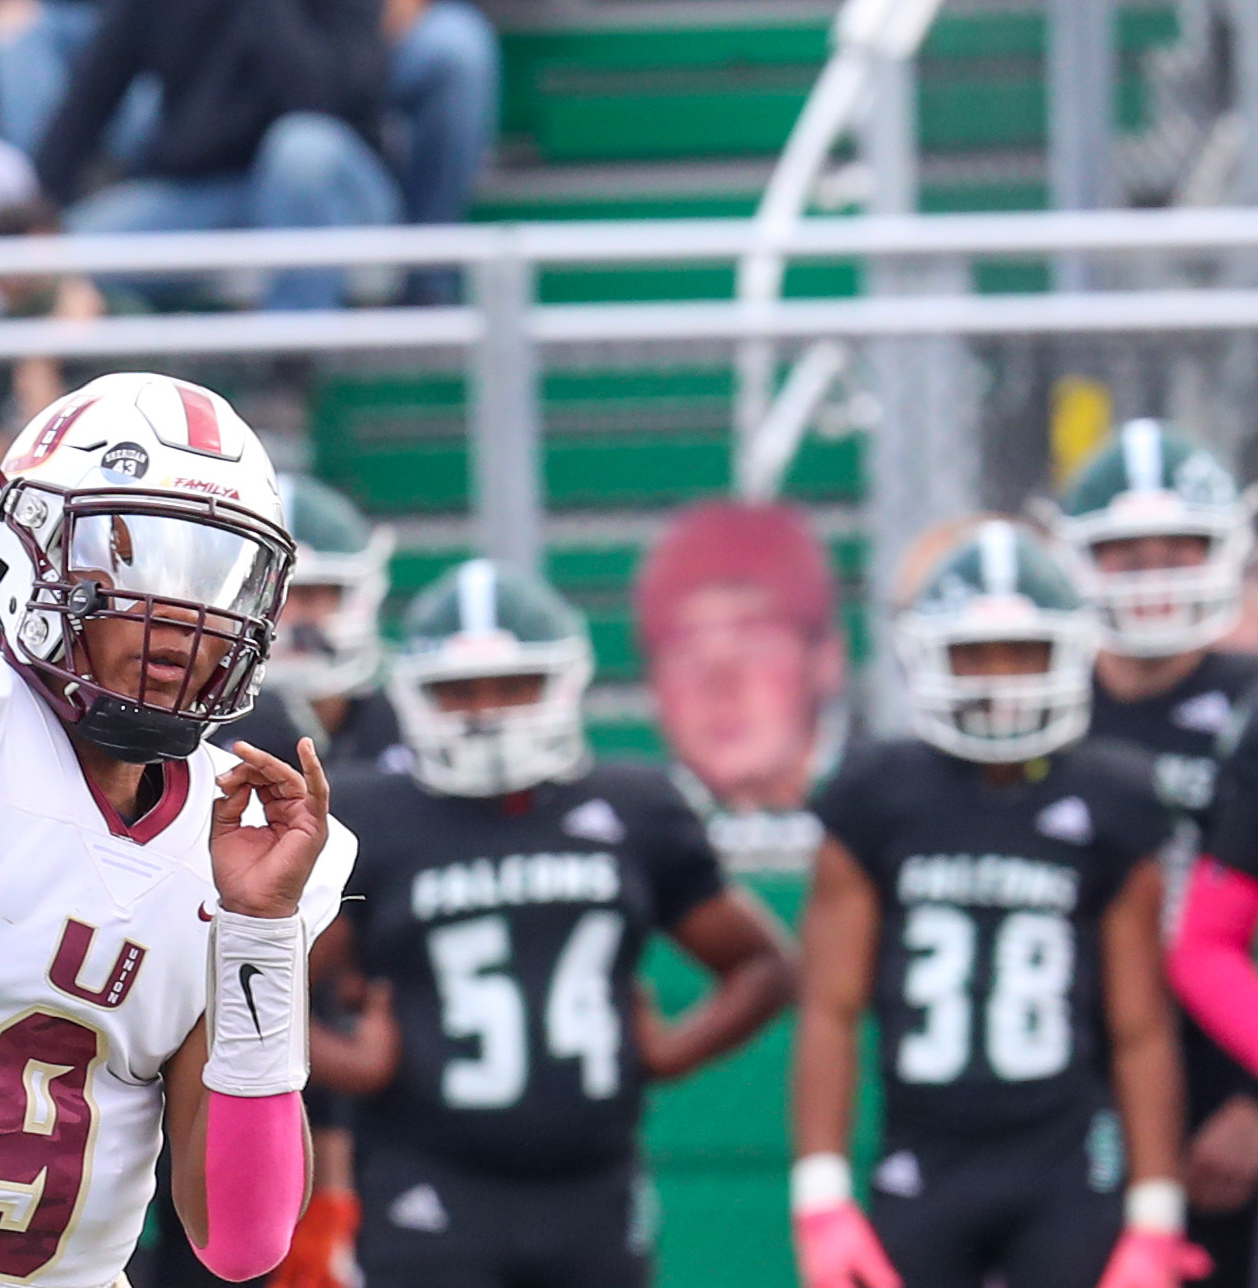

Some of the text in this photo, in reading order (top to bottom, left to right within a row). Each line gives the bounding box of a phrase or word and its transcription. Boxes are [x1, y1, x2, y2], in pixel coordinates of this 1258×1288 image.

[32, 397, 90, 458] NION
[173, 477, 233, 497] FAMILY
[45, 914, 150, 1012] U
[107, 947, 140, 1004] UNION
[896, 903, 1076, 1084] 38
[426, 910, 626, 1108] 54
